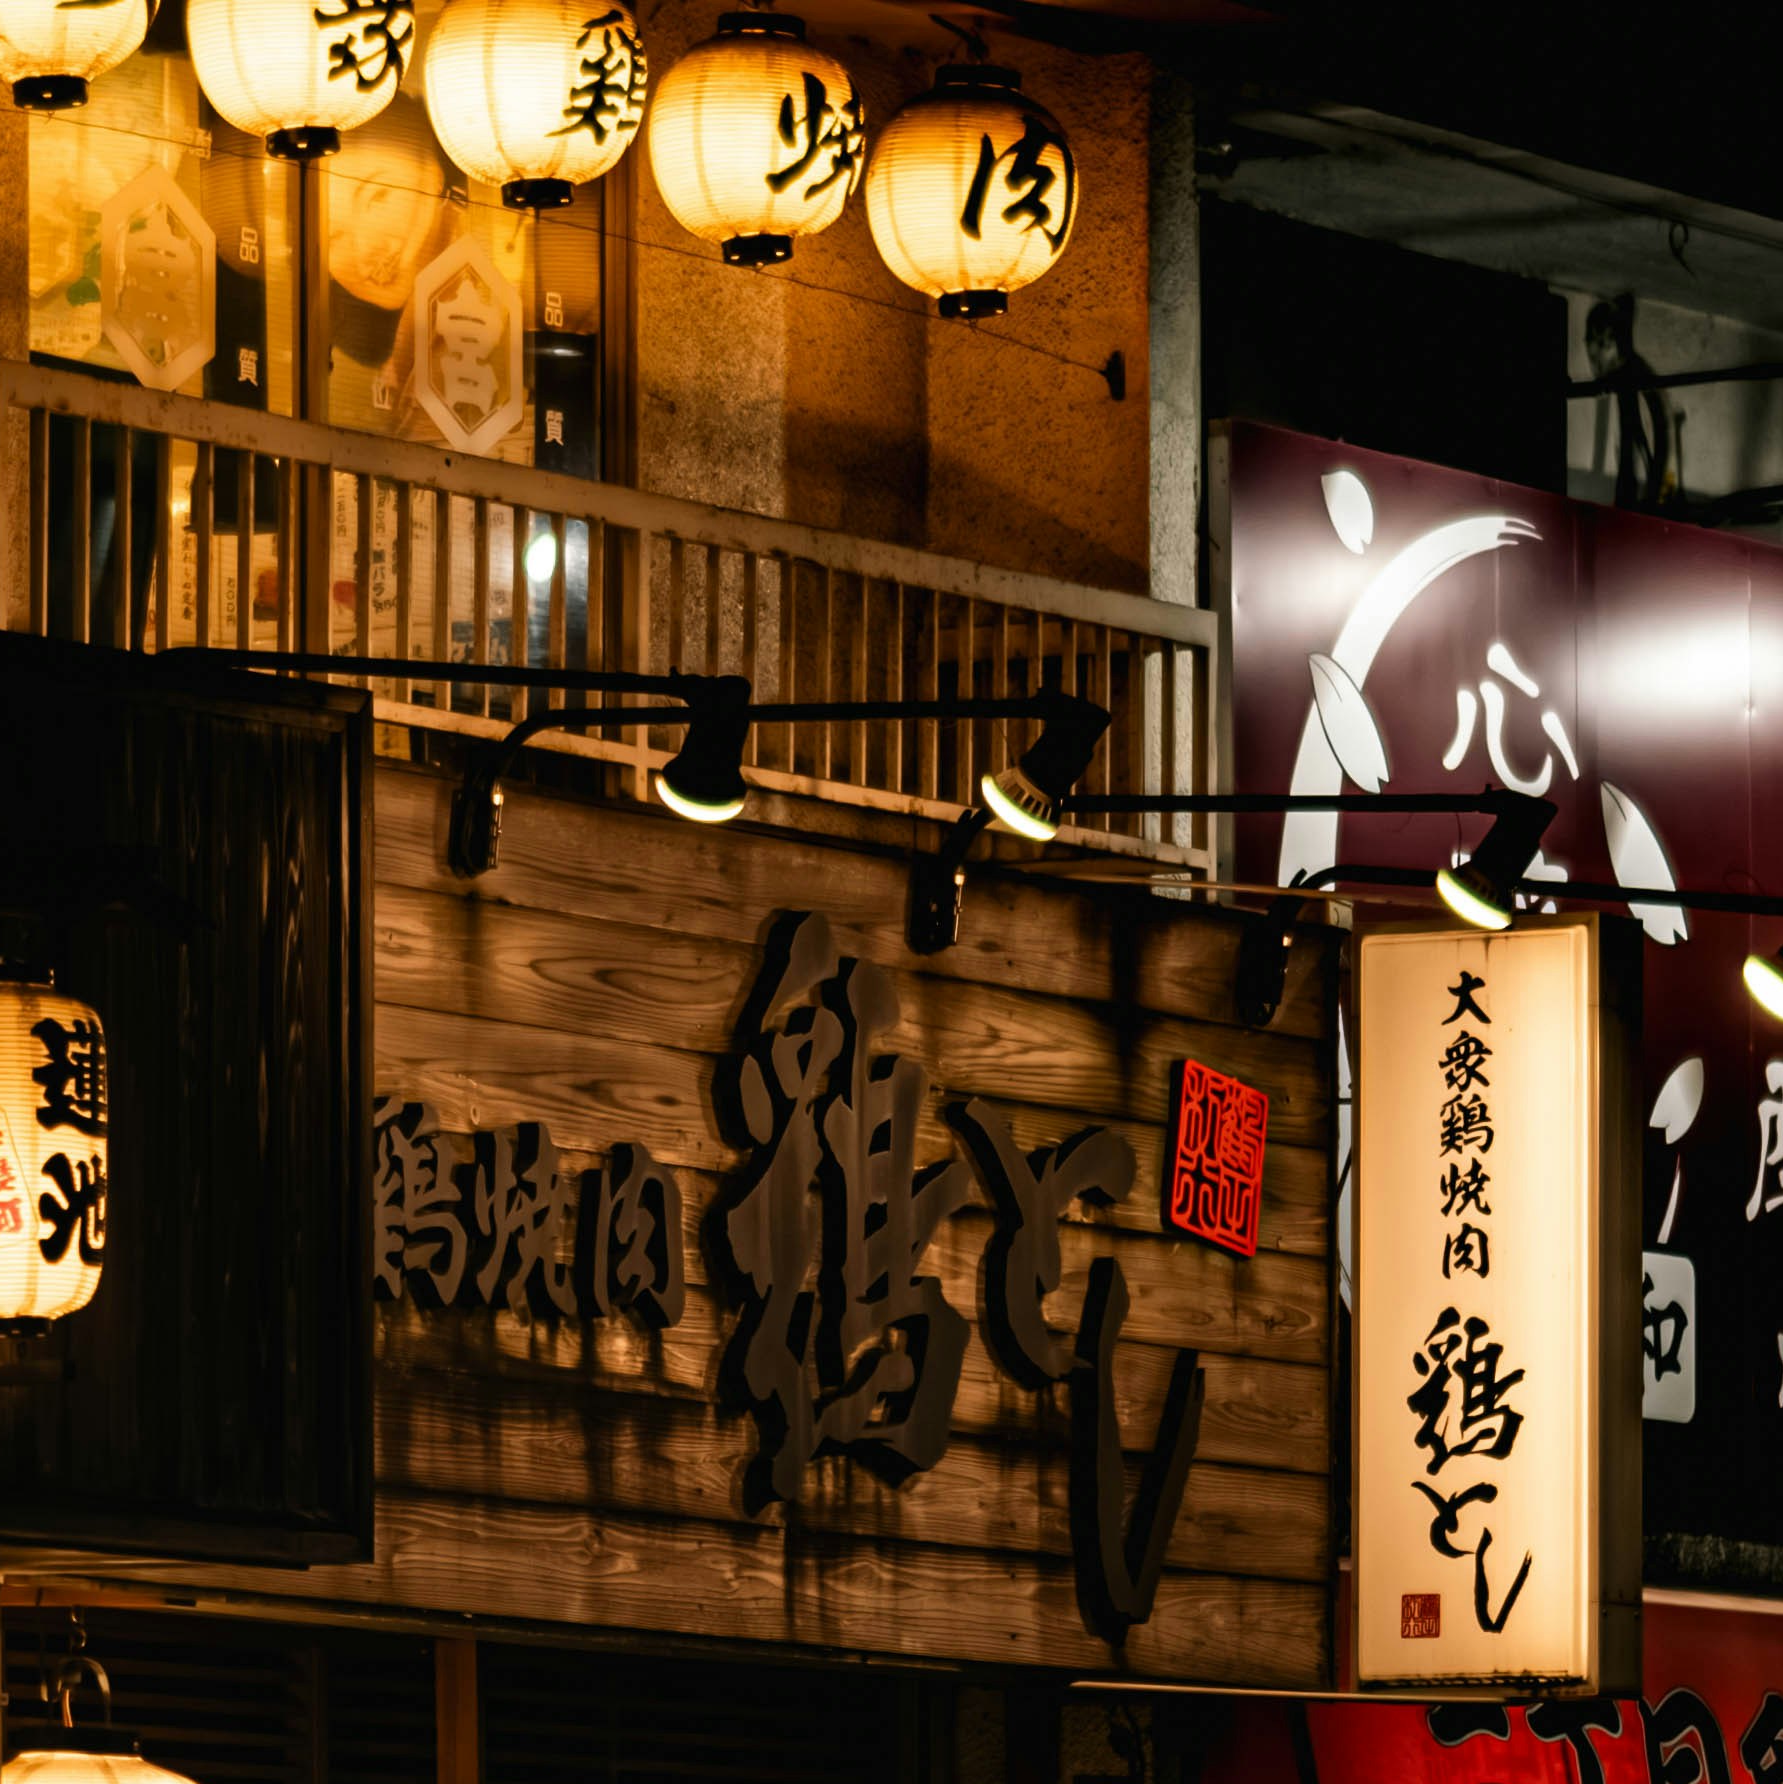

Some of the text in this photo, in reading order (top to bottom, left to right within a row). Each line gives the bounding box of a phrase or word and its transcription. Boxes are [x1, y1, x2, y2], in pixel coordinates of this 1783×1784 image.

[960, 115, 1076, 255] 肉
[716, 907, 1206, 1643] 鶏とし
[1406, 1305, 1532, 1633] 鶏とし
